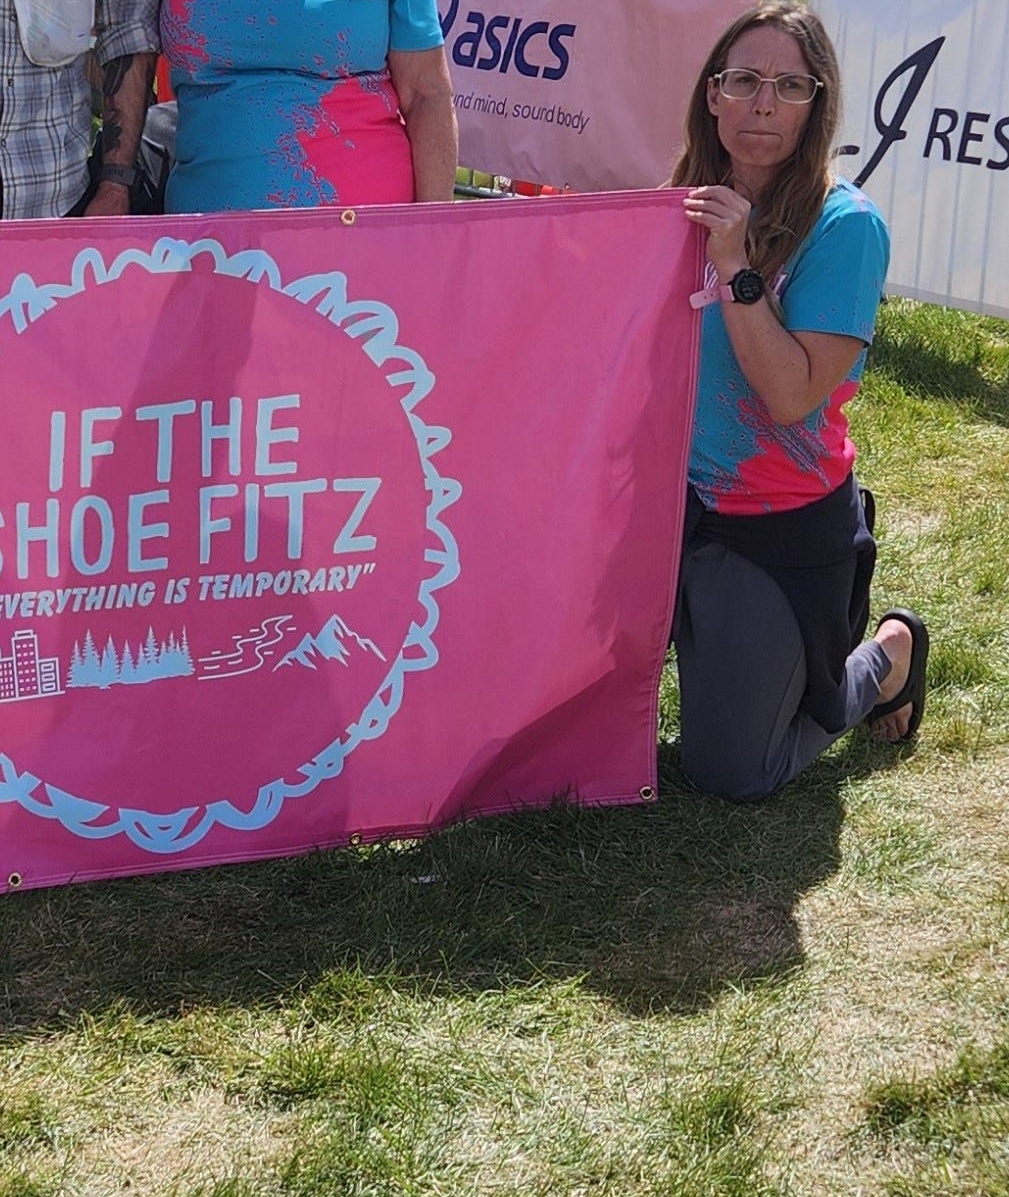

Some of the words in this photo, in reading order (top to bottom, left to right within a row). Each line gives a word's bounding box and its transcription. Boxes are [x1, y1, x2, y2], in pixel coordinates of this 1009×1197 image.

[474, 95, 508, 118] mind,
[557, 107, 590, 134] body
[49, 406, 123, 492] IF
[135, 394, 300, 483] THE
[199, 477, 382, 564] FITZ
[164, 577, 191, 604] IS
[198, 563, 377, 599] TEMPORARY"
